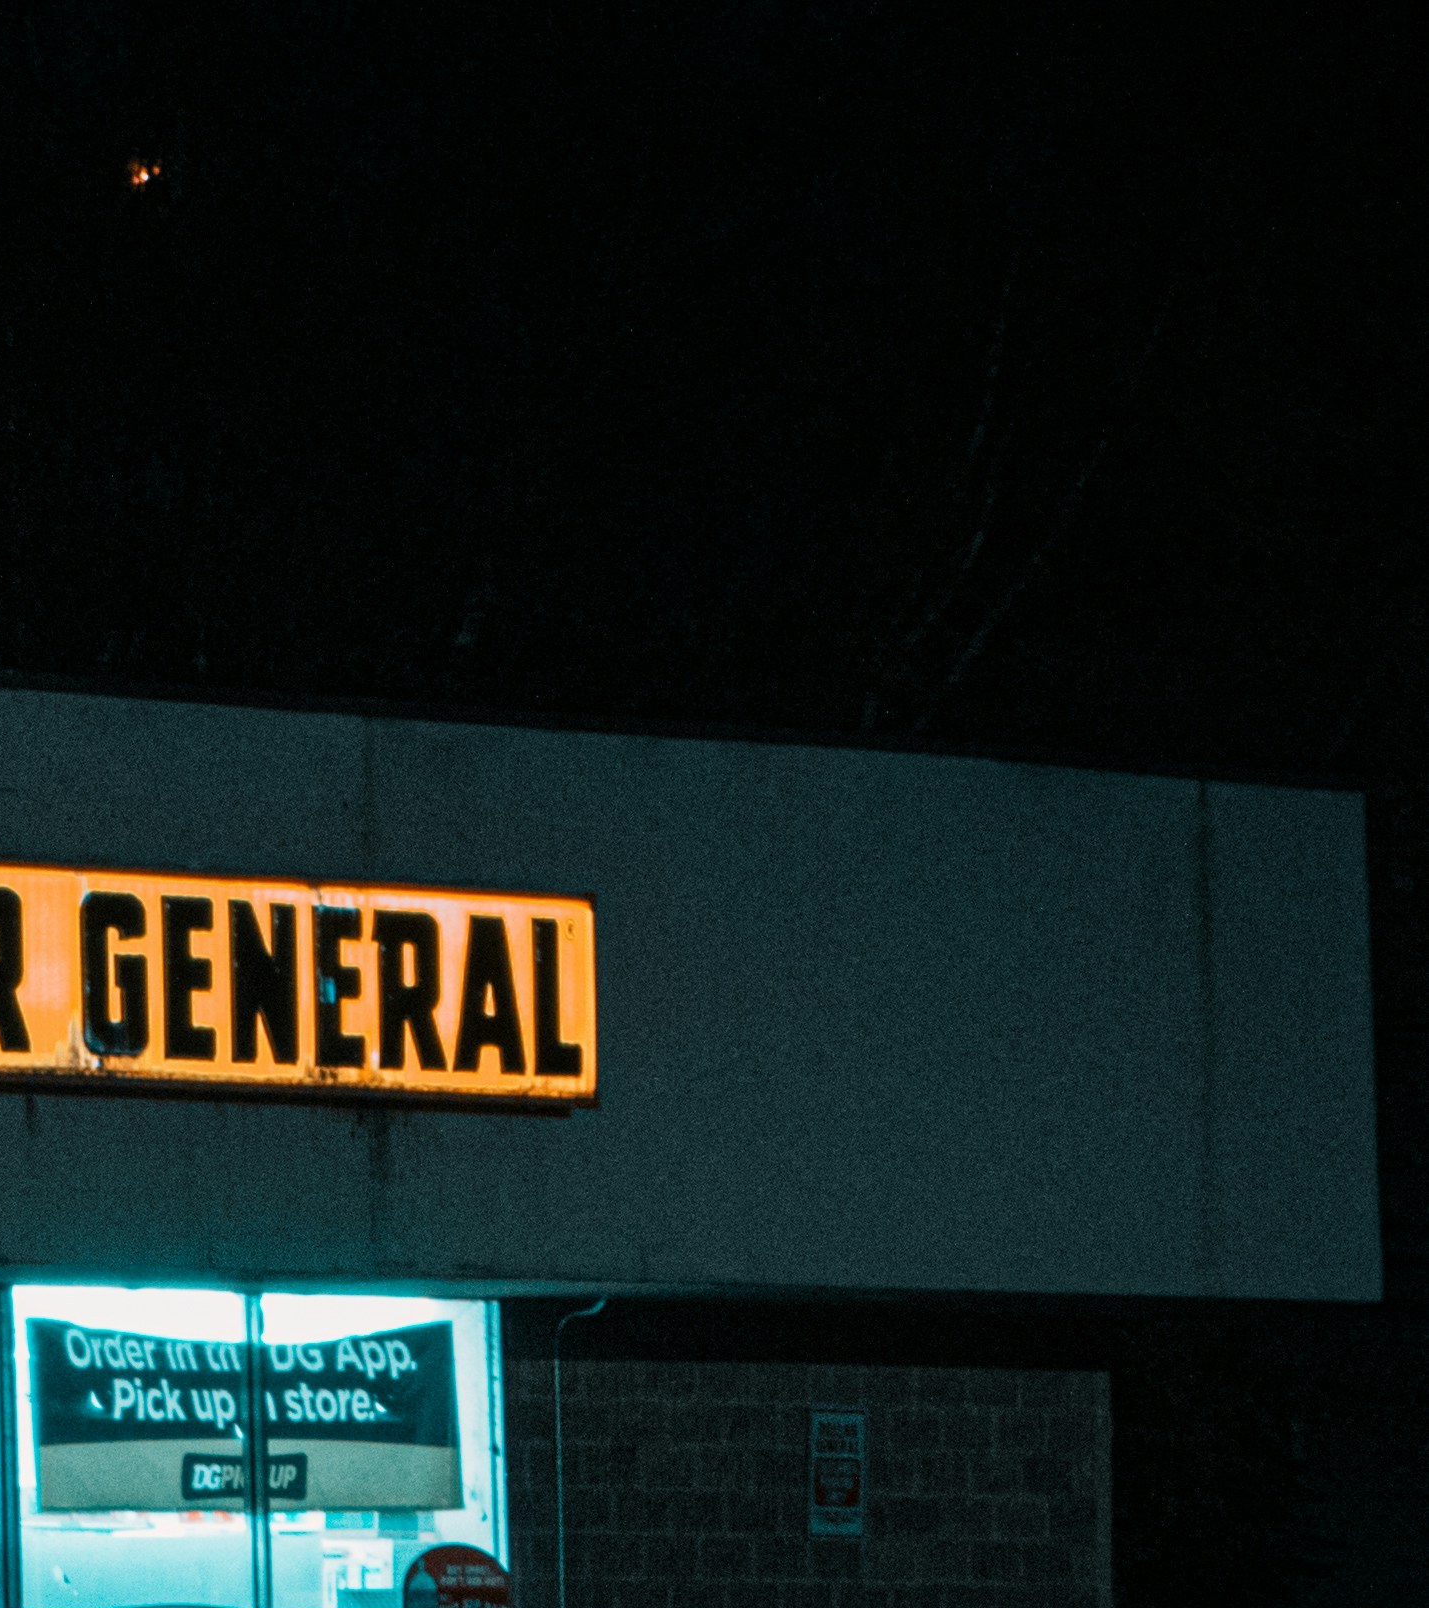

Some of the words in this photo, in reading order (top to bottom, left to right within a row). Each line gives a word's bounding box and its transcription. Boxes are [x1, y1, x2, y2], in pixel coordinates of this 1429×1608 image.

[80, 890, 582, 1077] GENERAL
[67, 1328, 156, 1370] Order
[166, 1342, 198, 1371] in
[206, 1342, 242, 1372] th
[337, 1338, 417, 1379] App.
[113, 1377, 187, 1420] Pick
[191, 1388, 236, 1429] up
[283, 1382, 376, 1422] store.
